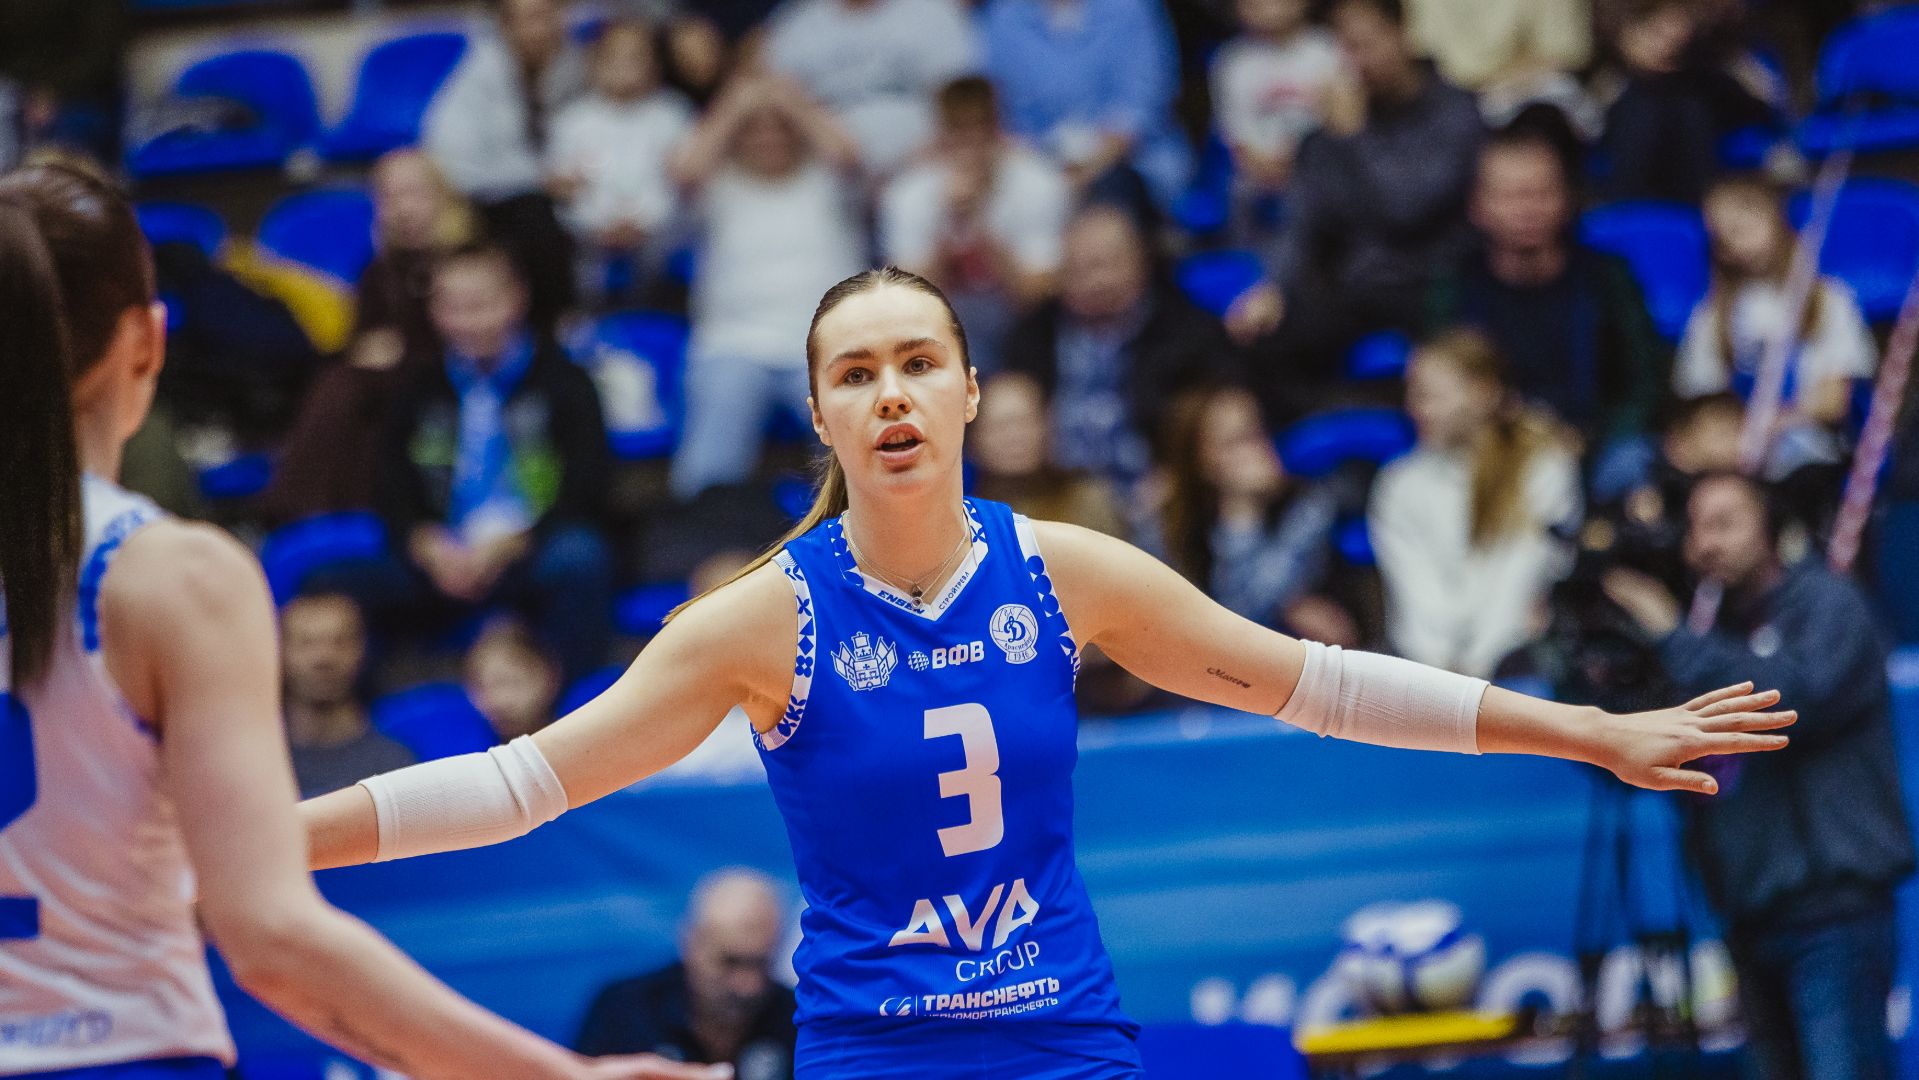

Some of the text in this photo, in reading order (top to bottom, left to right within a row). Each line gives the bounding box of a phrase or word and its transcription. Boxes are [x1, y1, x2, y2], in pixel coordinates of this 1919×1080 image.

[932, 640, 985, 669] ВФВ
[923, 702, 1004, 858] 3
[888, 878, 1040, 951] AVA
[922, 977, 1060, 1011] ТРАНСНЕФТЬ
[923, 997, 1058, 1020] НОМОРТРАНСНЕФТЬ
